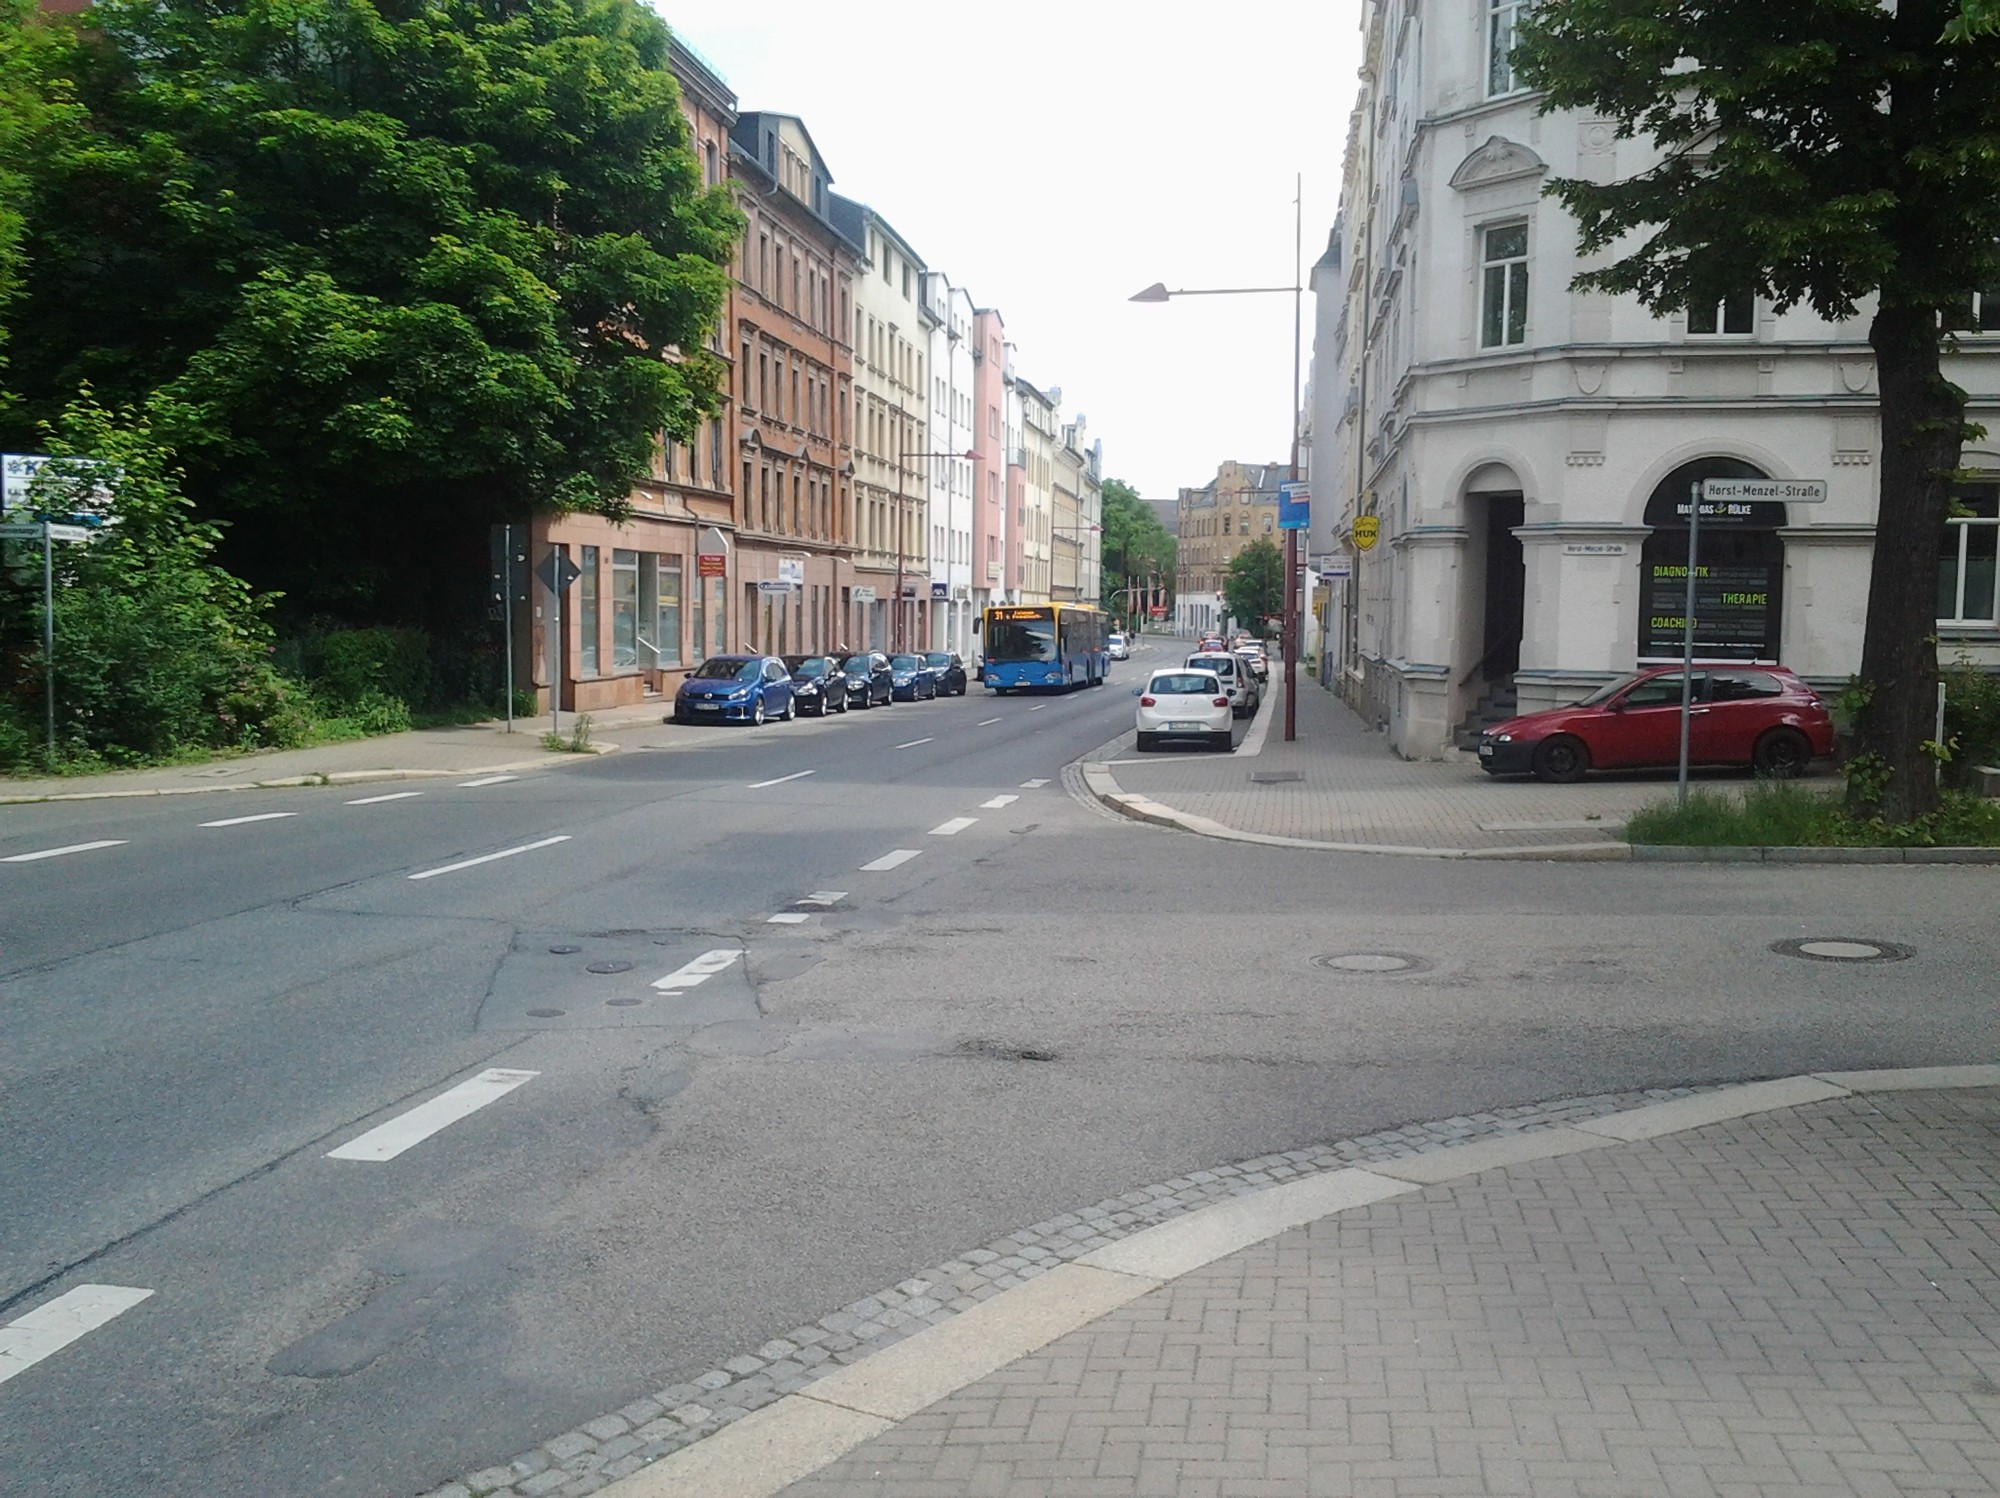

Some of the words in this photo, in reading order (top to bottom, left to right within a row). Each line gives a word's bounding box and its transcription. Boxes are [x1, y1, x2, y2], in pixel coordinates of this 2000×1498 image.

[1708, 484, 1821, 498] Horst-Menzel-Straße
[1354, 529, 1377, 538] HUK
[1653, 566, 1709, 578] DIAGNOTIK
[1722, 593, 1768, 605] THERAPIE
[1651, 617, 1698, 629] COACHIG
